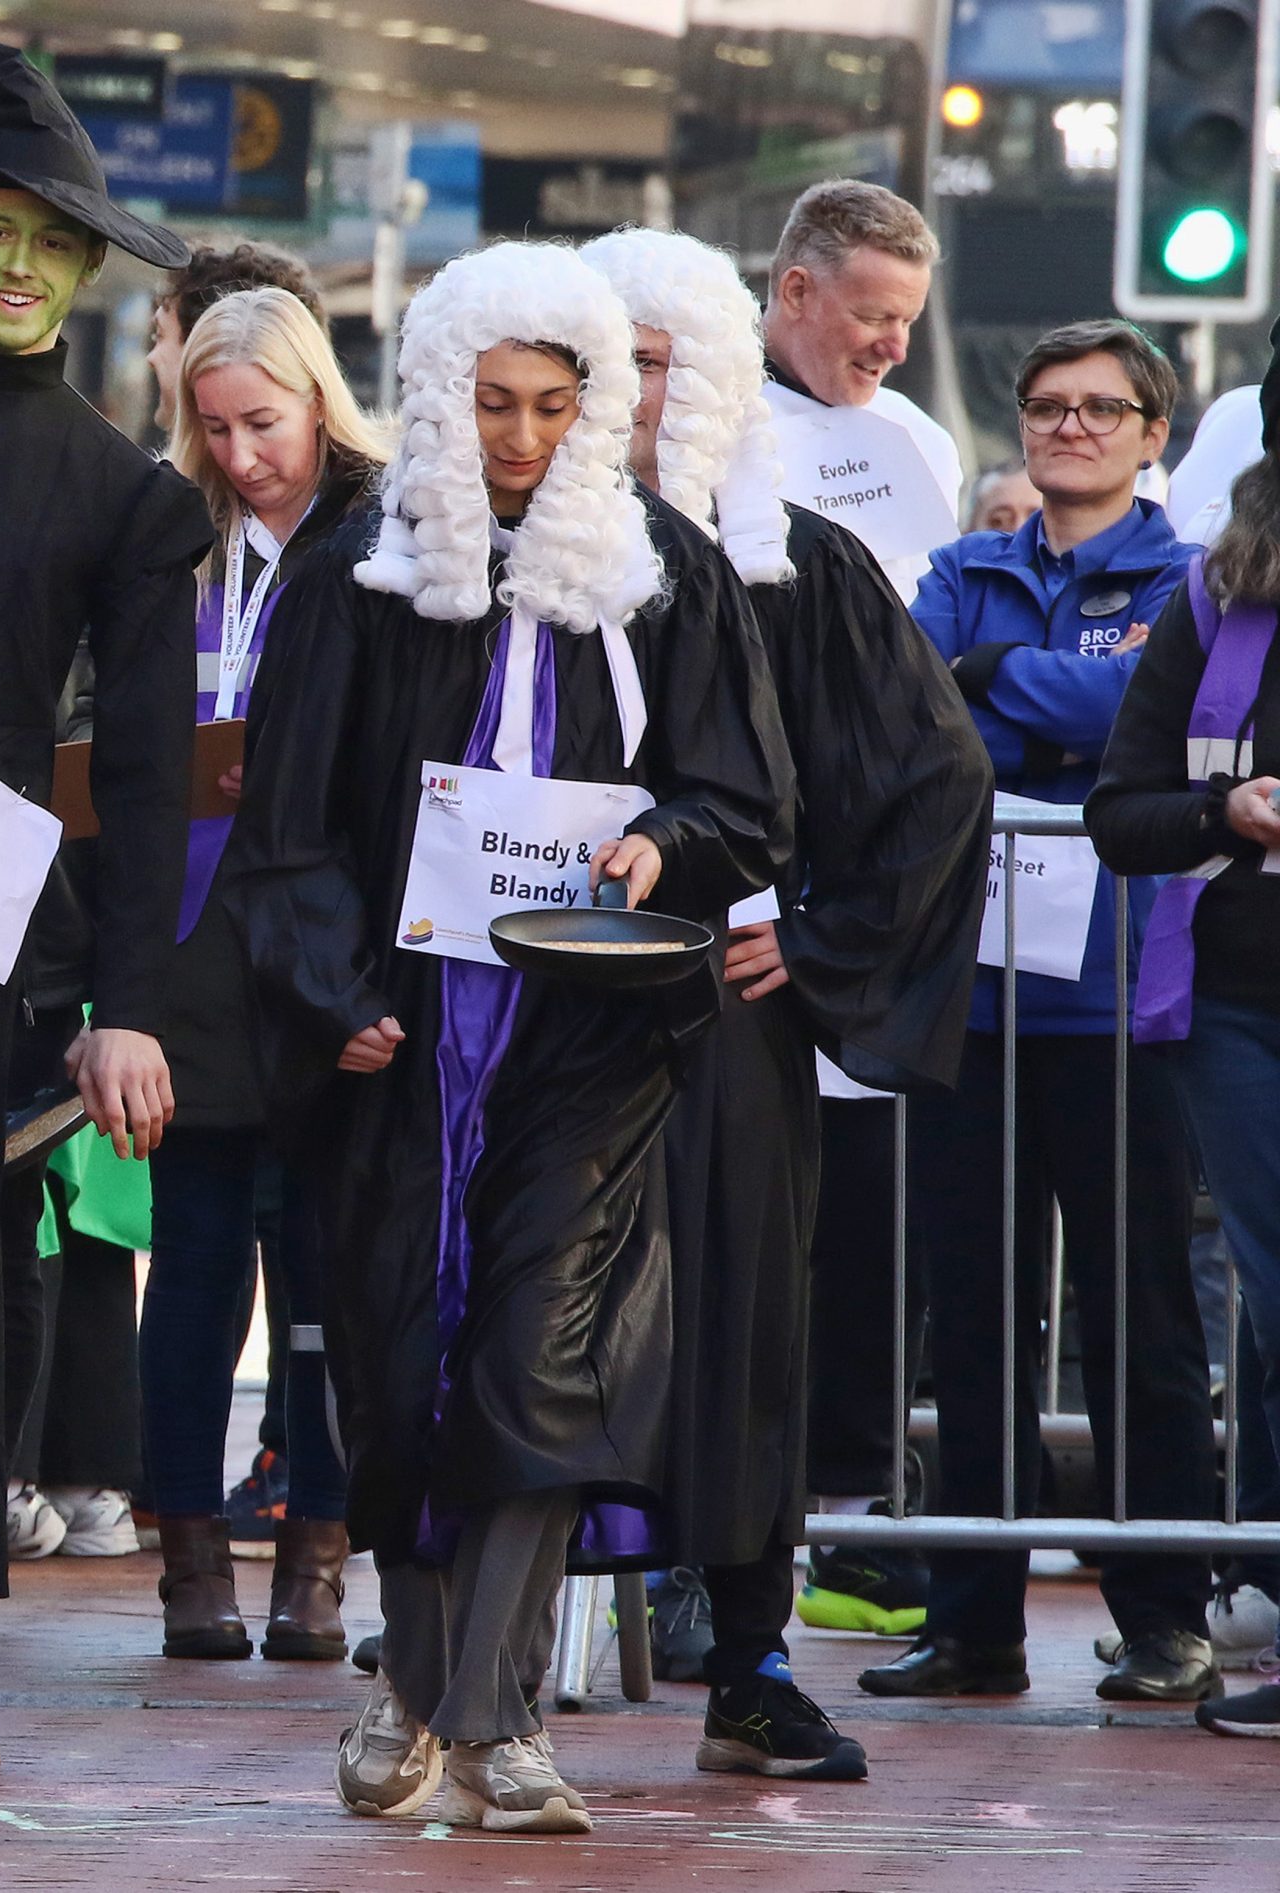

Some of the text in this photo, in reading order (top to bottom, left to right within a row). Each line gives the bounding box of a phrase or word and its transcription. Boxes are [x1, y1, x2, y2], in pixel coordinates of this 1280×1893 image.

[818, 458, 870, 480] Evoke
[813, 483, 892, 511] Transport
[226, 615, 234, 656] VOLUNTEER
[1079, 628, 1121, 646] BRO
[481, 830, 592, 869] Blandy &
[987, 850, 1046, 877] Steet
[490, 873, 579, 908] Blandy
